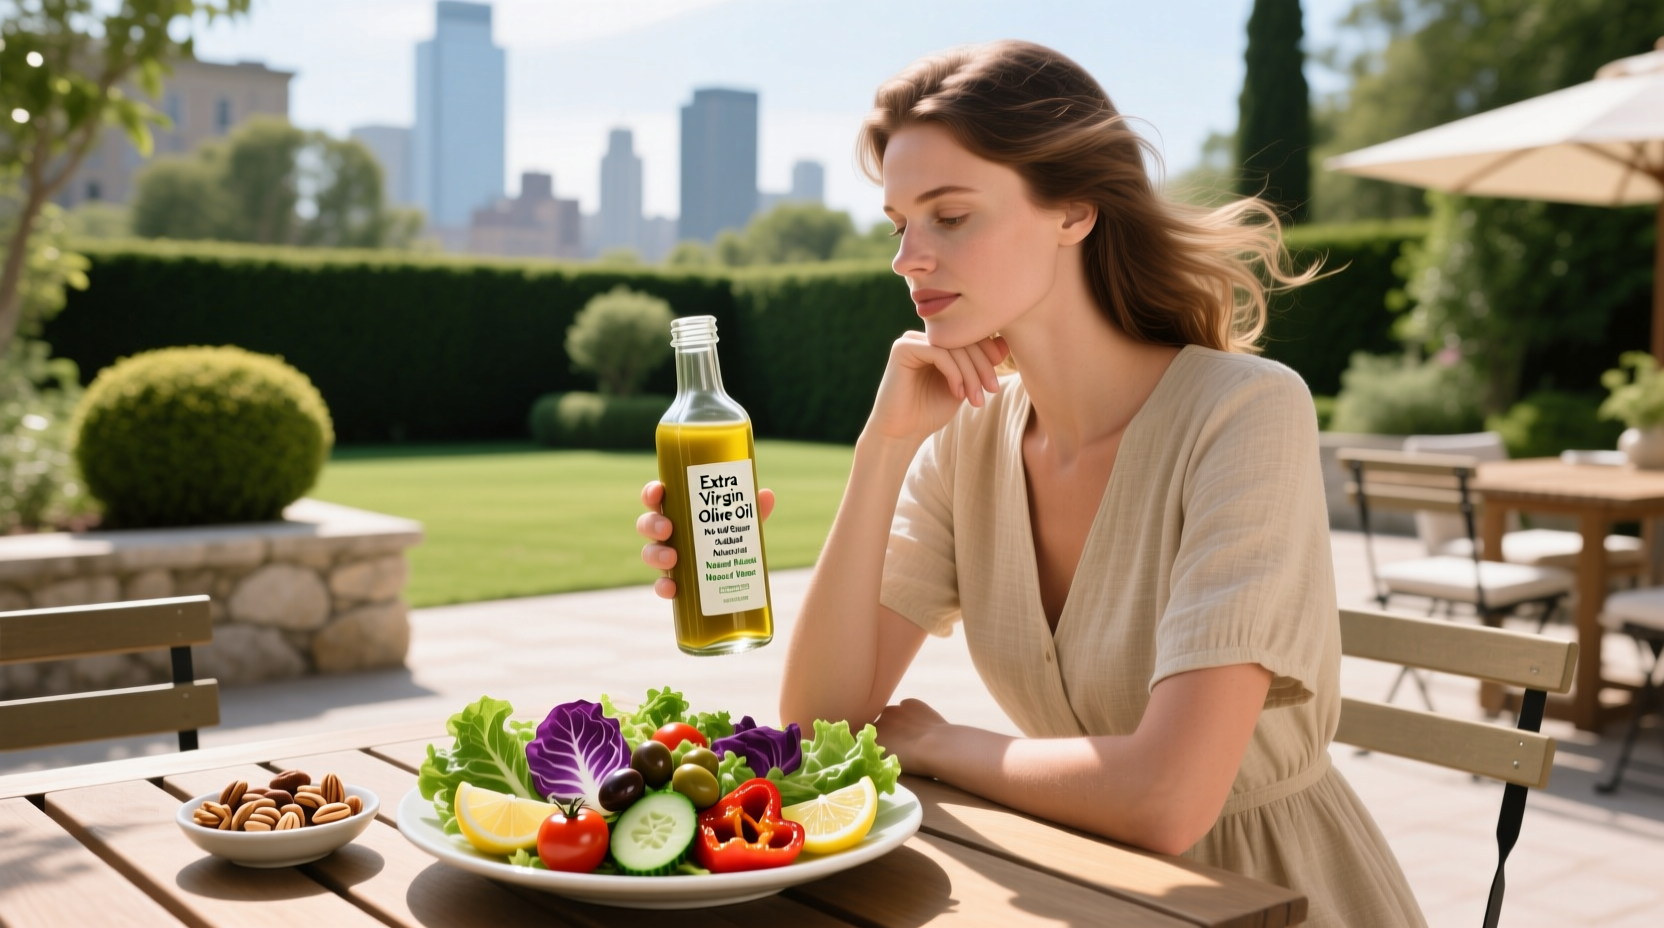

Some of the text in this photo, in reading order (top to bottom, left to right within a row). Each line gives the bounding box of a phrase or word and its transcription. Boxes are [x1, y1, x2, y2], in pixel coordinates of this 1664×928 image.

[699, 474, 738, 490] Extra
[698, 488, 744, 507] Virgin
[698, 502, 753, 523] Olive Oil
